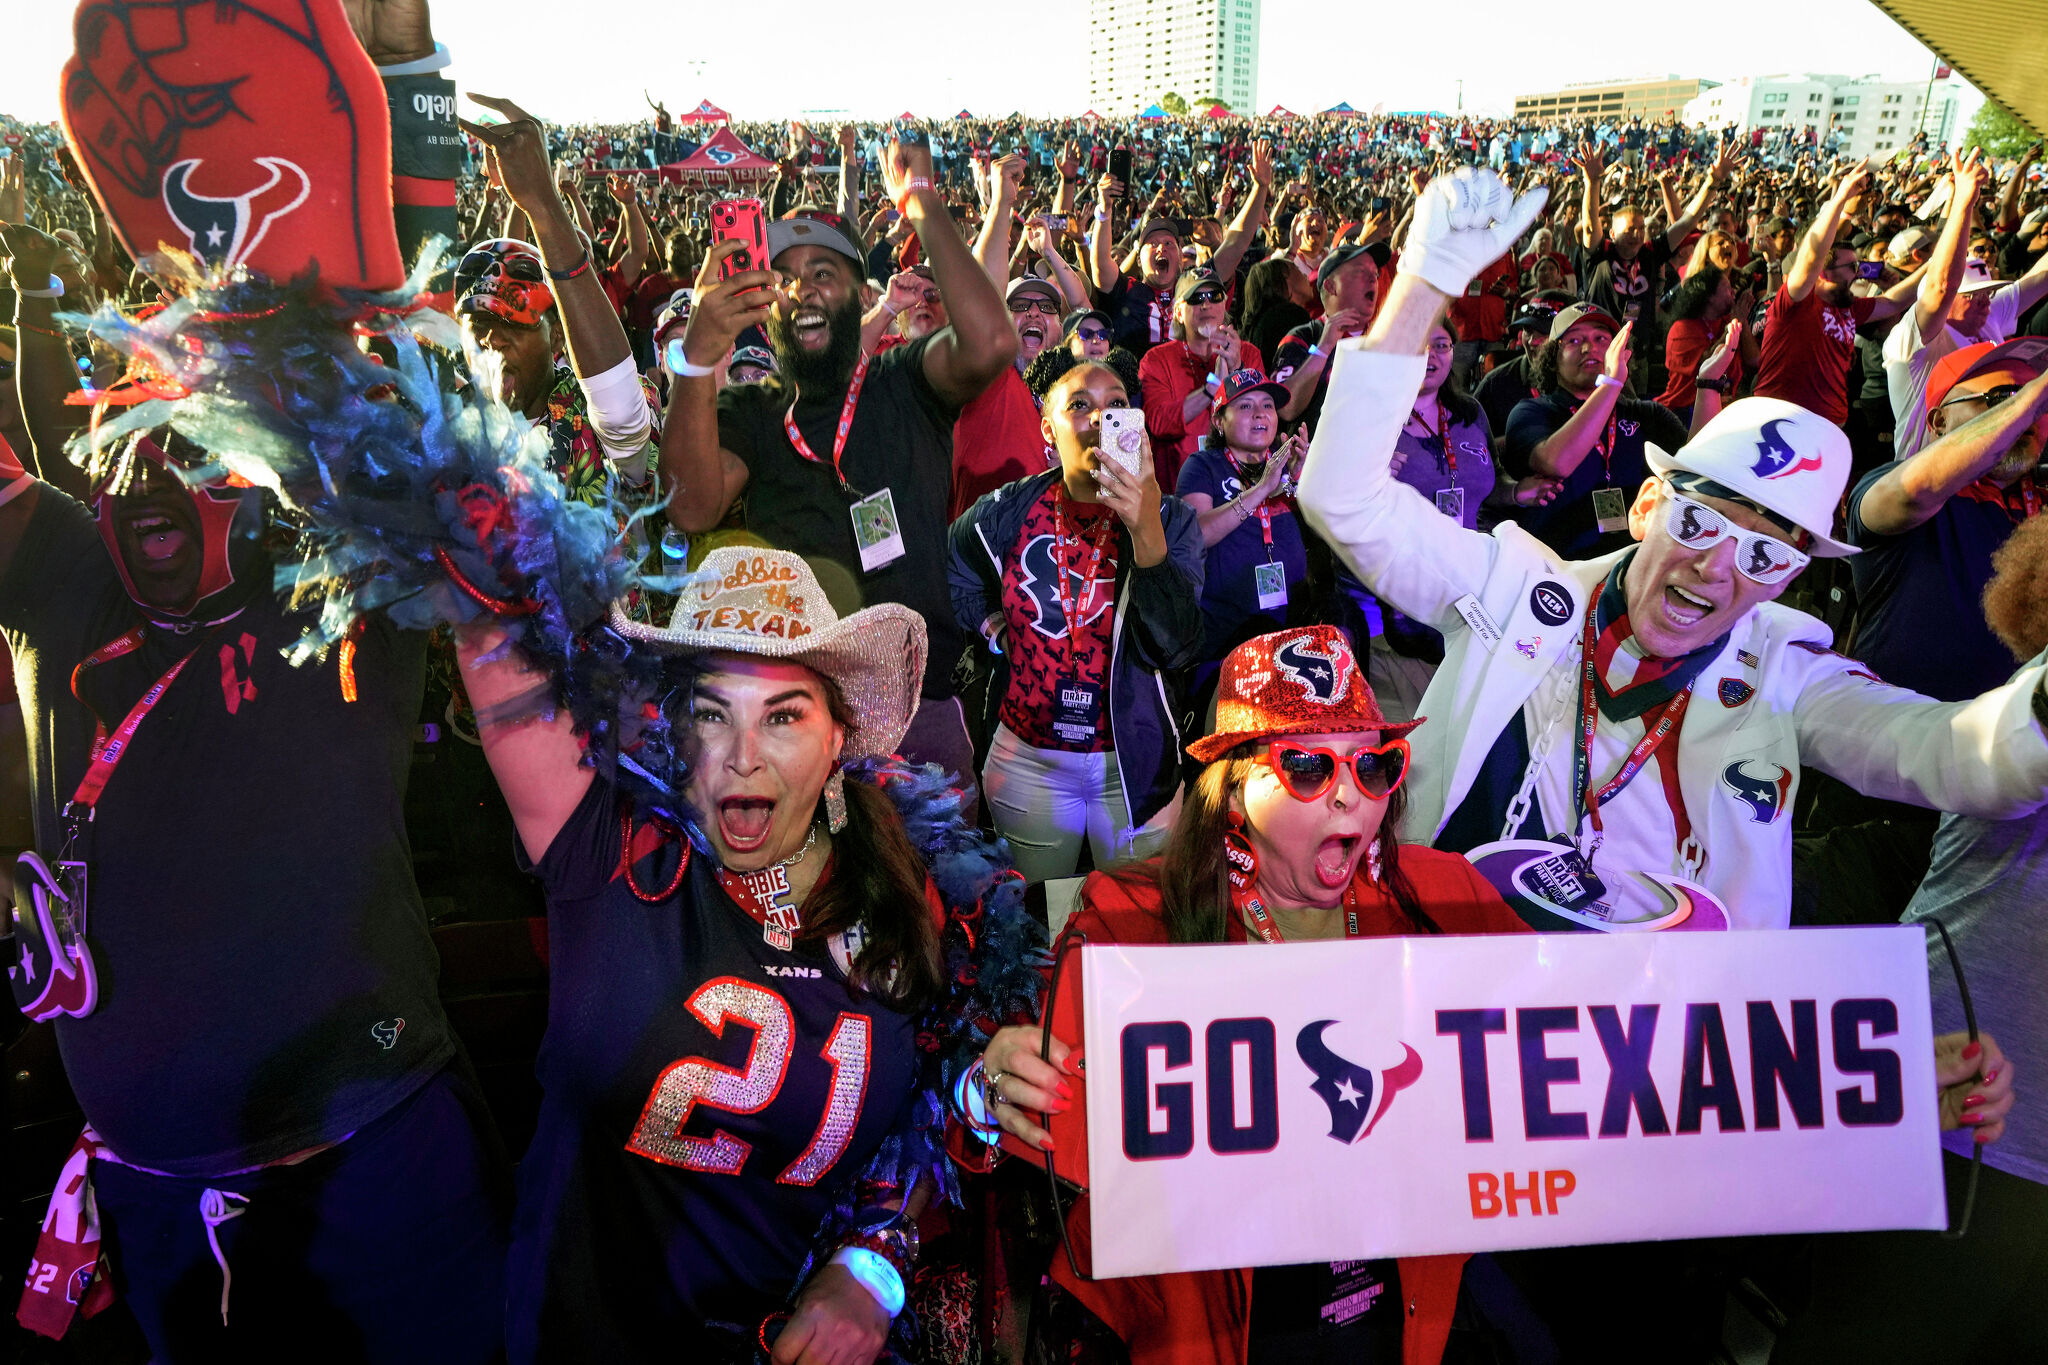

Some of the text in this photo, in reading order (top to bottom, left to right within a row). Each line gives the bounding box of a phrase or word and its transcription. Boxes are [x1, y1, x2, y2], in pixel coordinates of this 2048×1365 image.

[413, 93, 457, 122] delo
[765, 583, 804, 614] the
[1467, 611, 1490, 641] Bruce Fox
[1470, 602, 1501, 641] Commissioner
[1063, 691, 1091, 703] DRAFT
[124, 712, 146, 736] Modelo
[1656, 717, 1673, 738] DRAFT
[103, 741, 122, 763] DRAFT
[1634, 737, 1653, 756] Modelo
[1534, 863, 1554, 888] PARTY
[1544, 857, 1581, 896] DRAFT
[1250, 899, 1267, 922] DRAFT
[768, 932, 789, 947] NFL
[760, 964, 822, 979] XANS
[624, 975, 872, 1188] 21
[1120, 997, 1905, 1163] GO TEXANS
[1467, 1169, 1577, 1220] BHP
